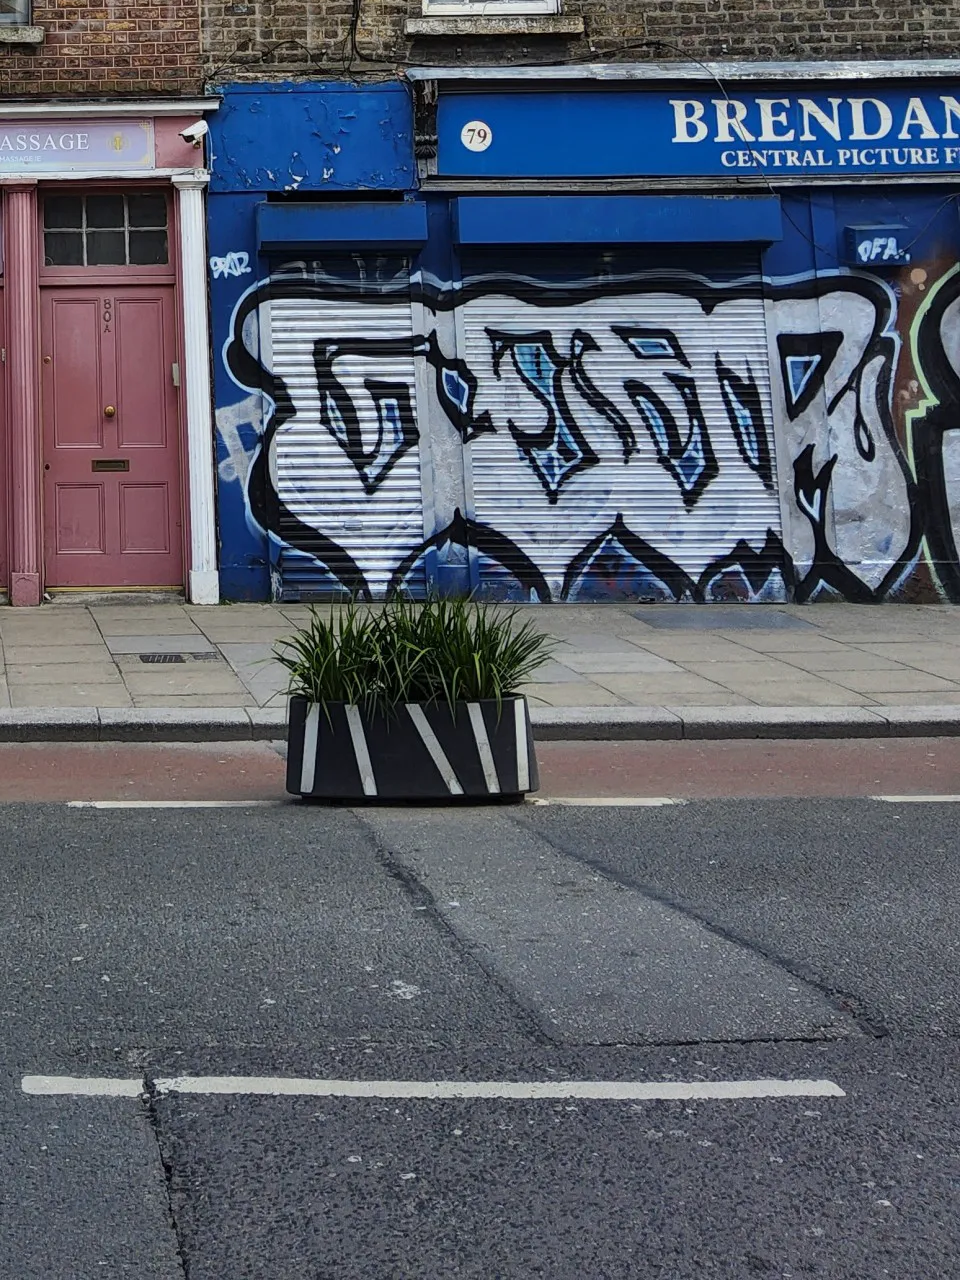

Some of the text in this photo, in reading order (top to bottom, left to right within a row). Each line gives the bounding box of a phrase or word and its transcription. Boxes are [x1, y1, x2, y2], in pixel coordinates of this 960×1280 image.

[467, 128, 487, 144] 79
[720, 150, 833, 167] CENTRAL
[838, 148, 939, 166] PICTURE
